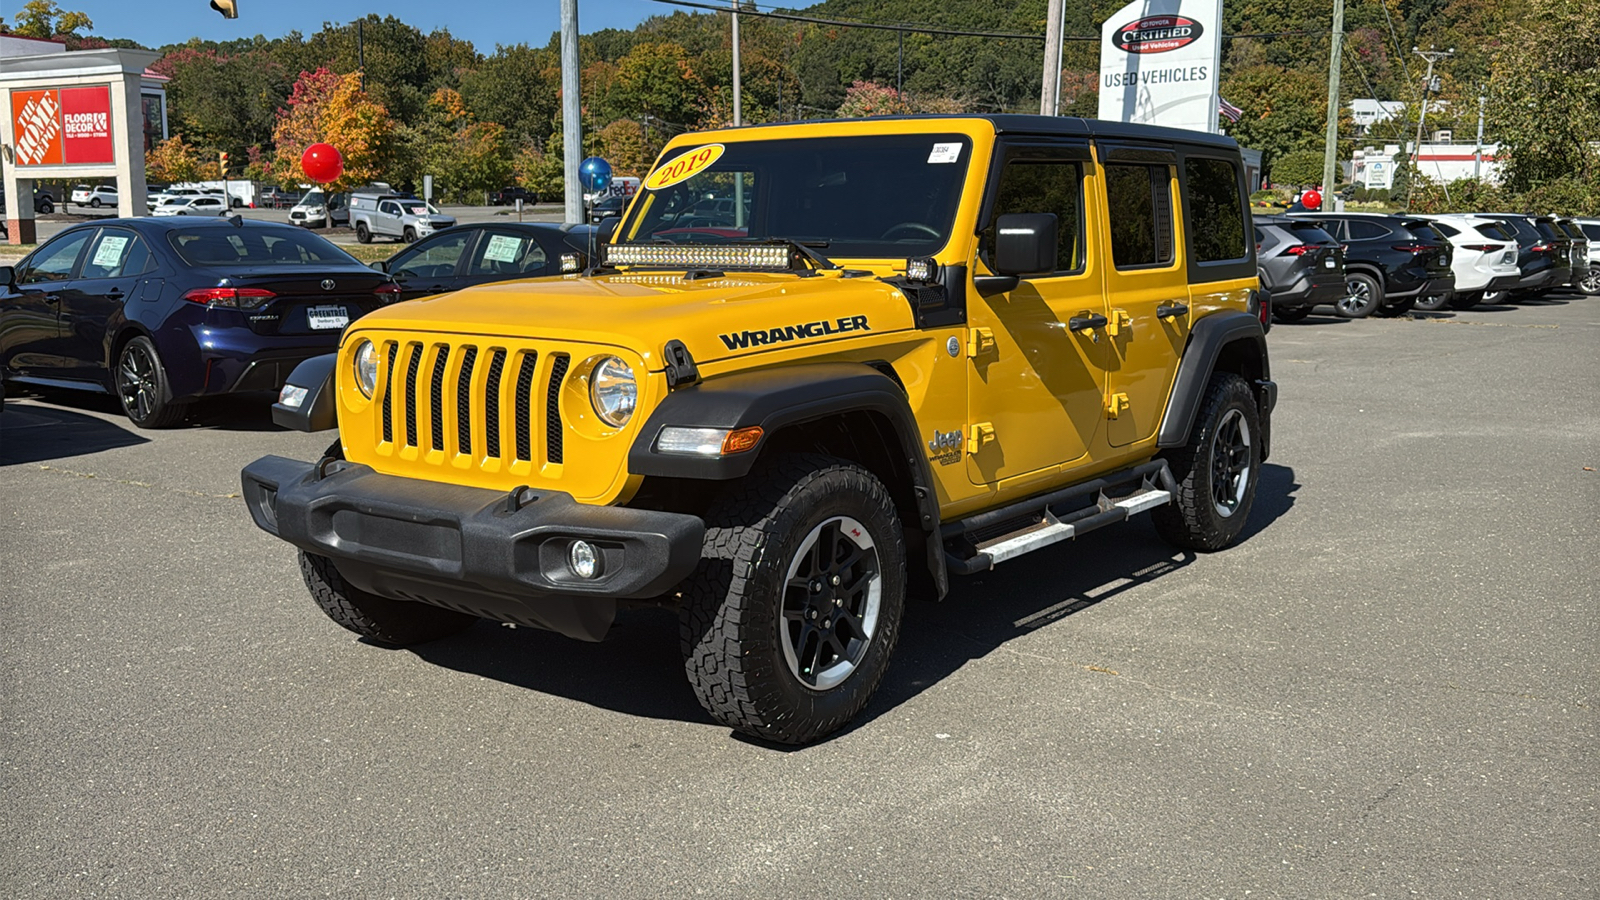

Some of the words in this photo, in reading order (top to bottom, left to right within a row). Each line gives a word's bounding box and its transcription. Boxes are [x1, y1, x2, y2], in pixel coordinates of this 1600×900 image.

[1148, 19, 1170, 27] TOYOTA
[1121, 27, 1192, 43] CERTIFIED
[1132, 43, 1149, 51] Used
[1150, 41, 1179, 49] Vehicles
[1104, 71, 1138, 88] USED
[1142, 66, 1207, 85] VEHICLES
[17, 96, 38, 128] THE
[64, 113, 93, 123] FLOOR
[16, 90, 59, 165] HOME
[65, 122, 94, 133] DECOR
[32, 116, 61, 165] DEPOT
[658, 149, 712, 185] 2019
[609, 180, 637, 196] FedEx
[309, 309, 346, 319] GREENTREE
[719, 315, 871, 350] WRANGLER
[928, 430, 962, 450] Jeep
